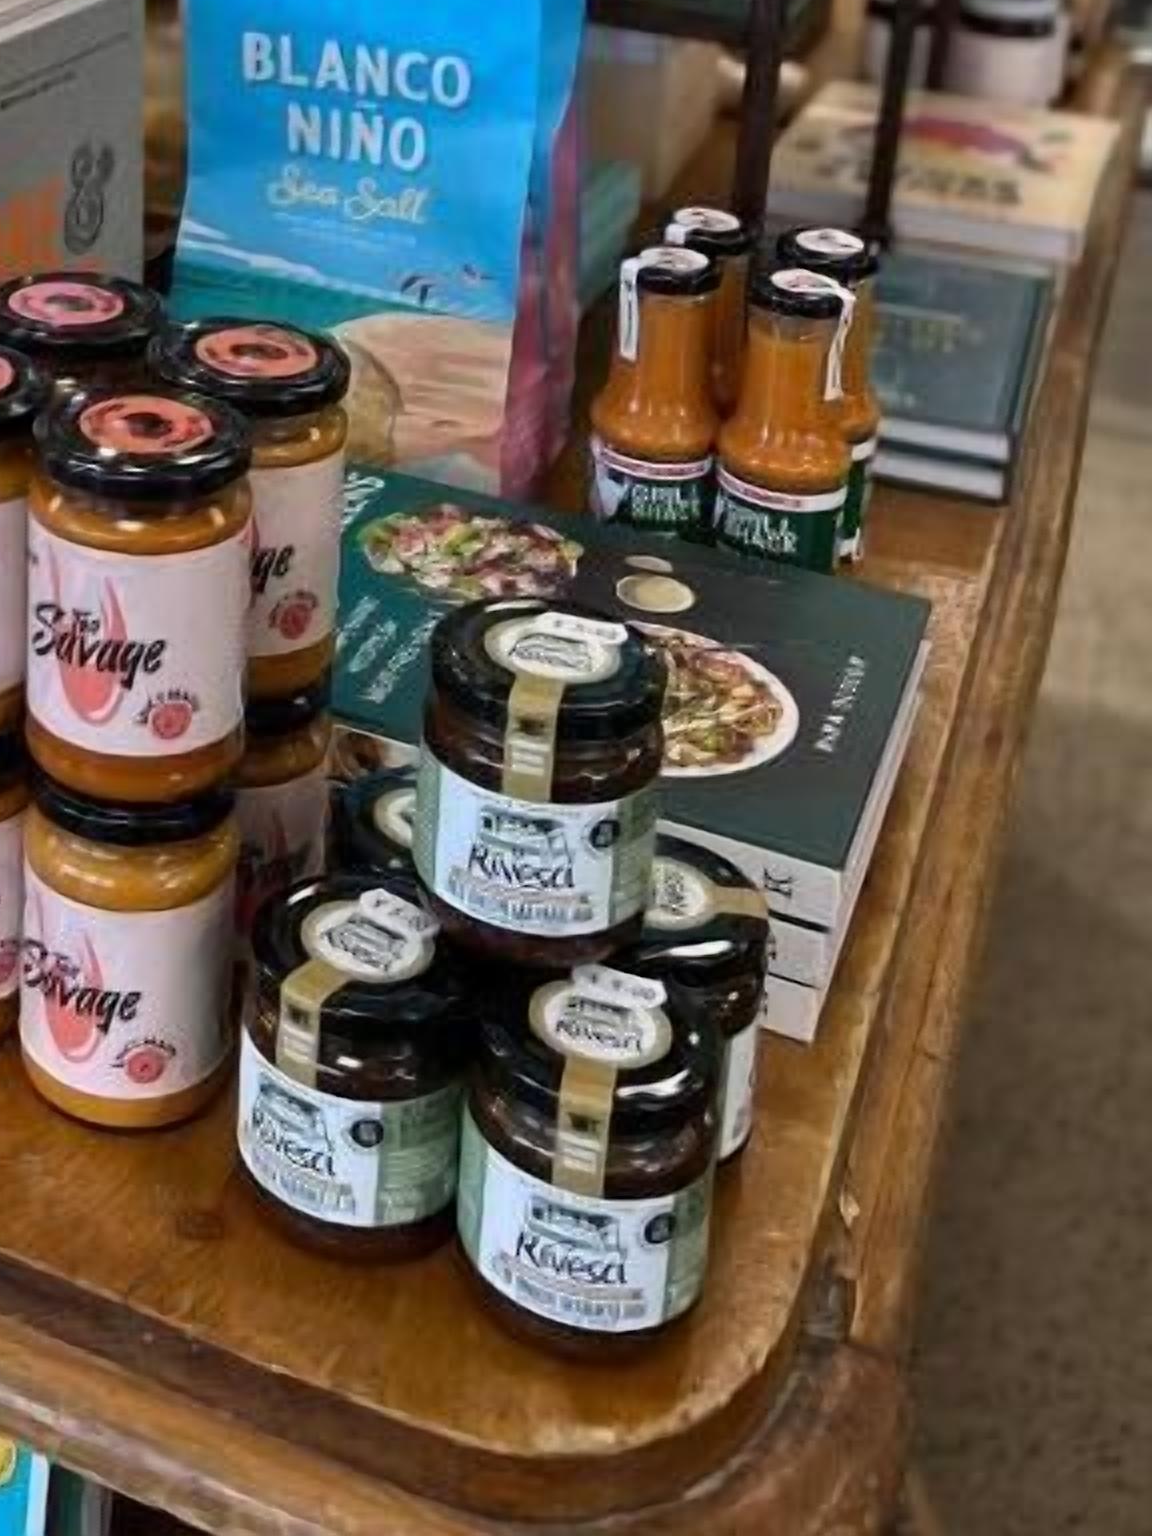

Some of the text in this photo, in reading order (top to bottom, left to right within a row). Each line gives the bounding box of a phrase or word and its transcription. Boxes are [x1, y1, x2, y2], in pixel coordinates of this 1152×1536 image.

[240, 30, 473, 110] BLANCO
[286, 99, 428, 173] NIÑO
[266, 163, 430, 226] Sea Salt
[31, 602, 167, 691] Savage
[21, 937, 142, 1035] Savage
